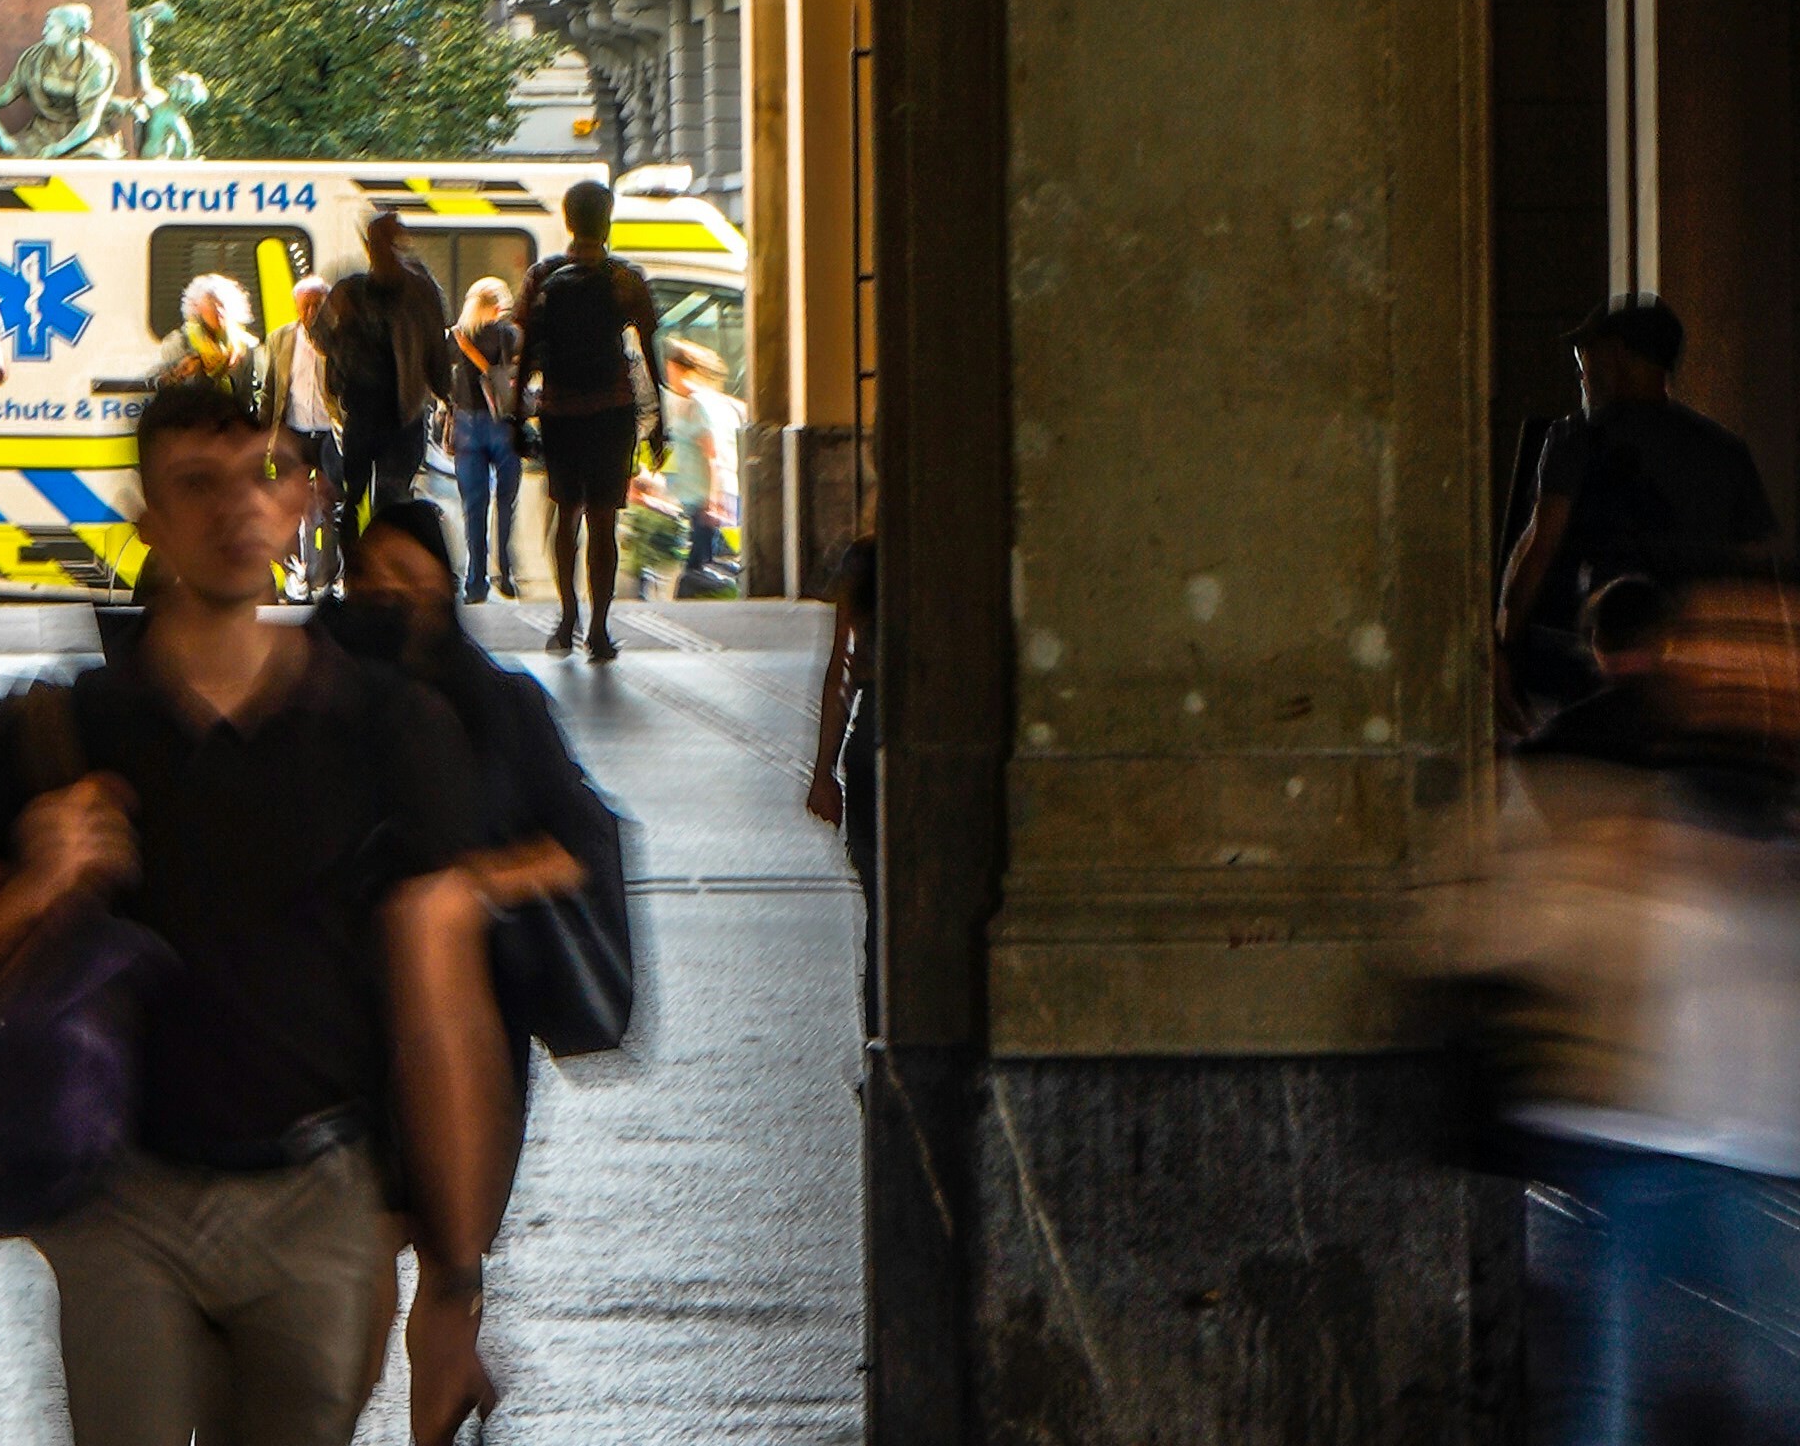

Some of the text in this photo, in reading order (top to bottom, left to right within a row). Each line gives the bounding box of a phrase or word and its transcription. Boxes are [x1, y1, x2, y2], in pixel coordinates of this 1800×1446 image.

[111, 179, 318, 213] Notruf 144
[73, 398, 92, 420] &
